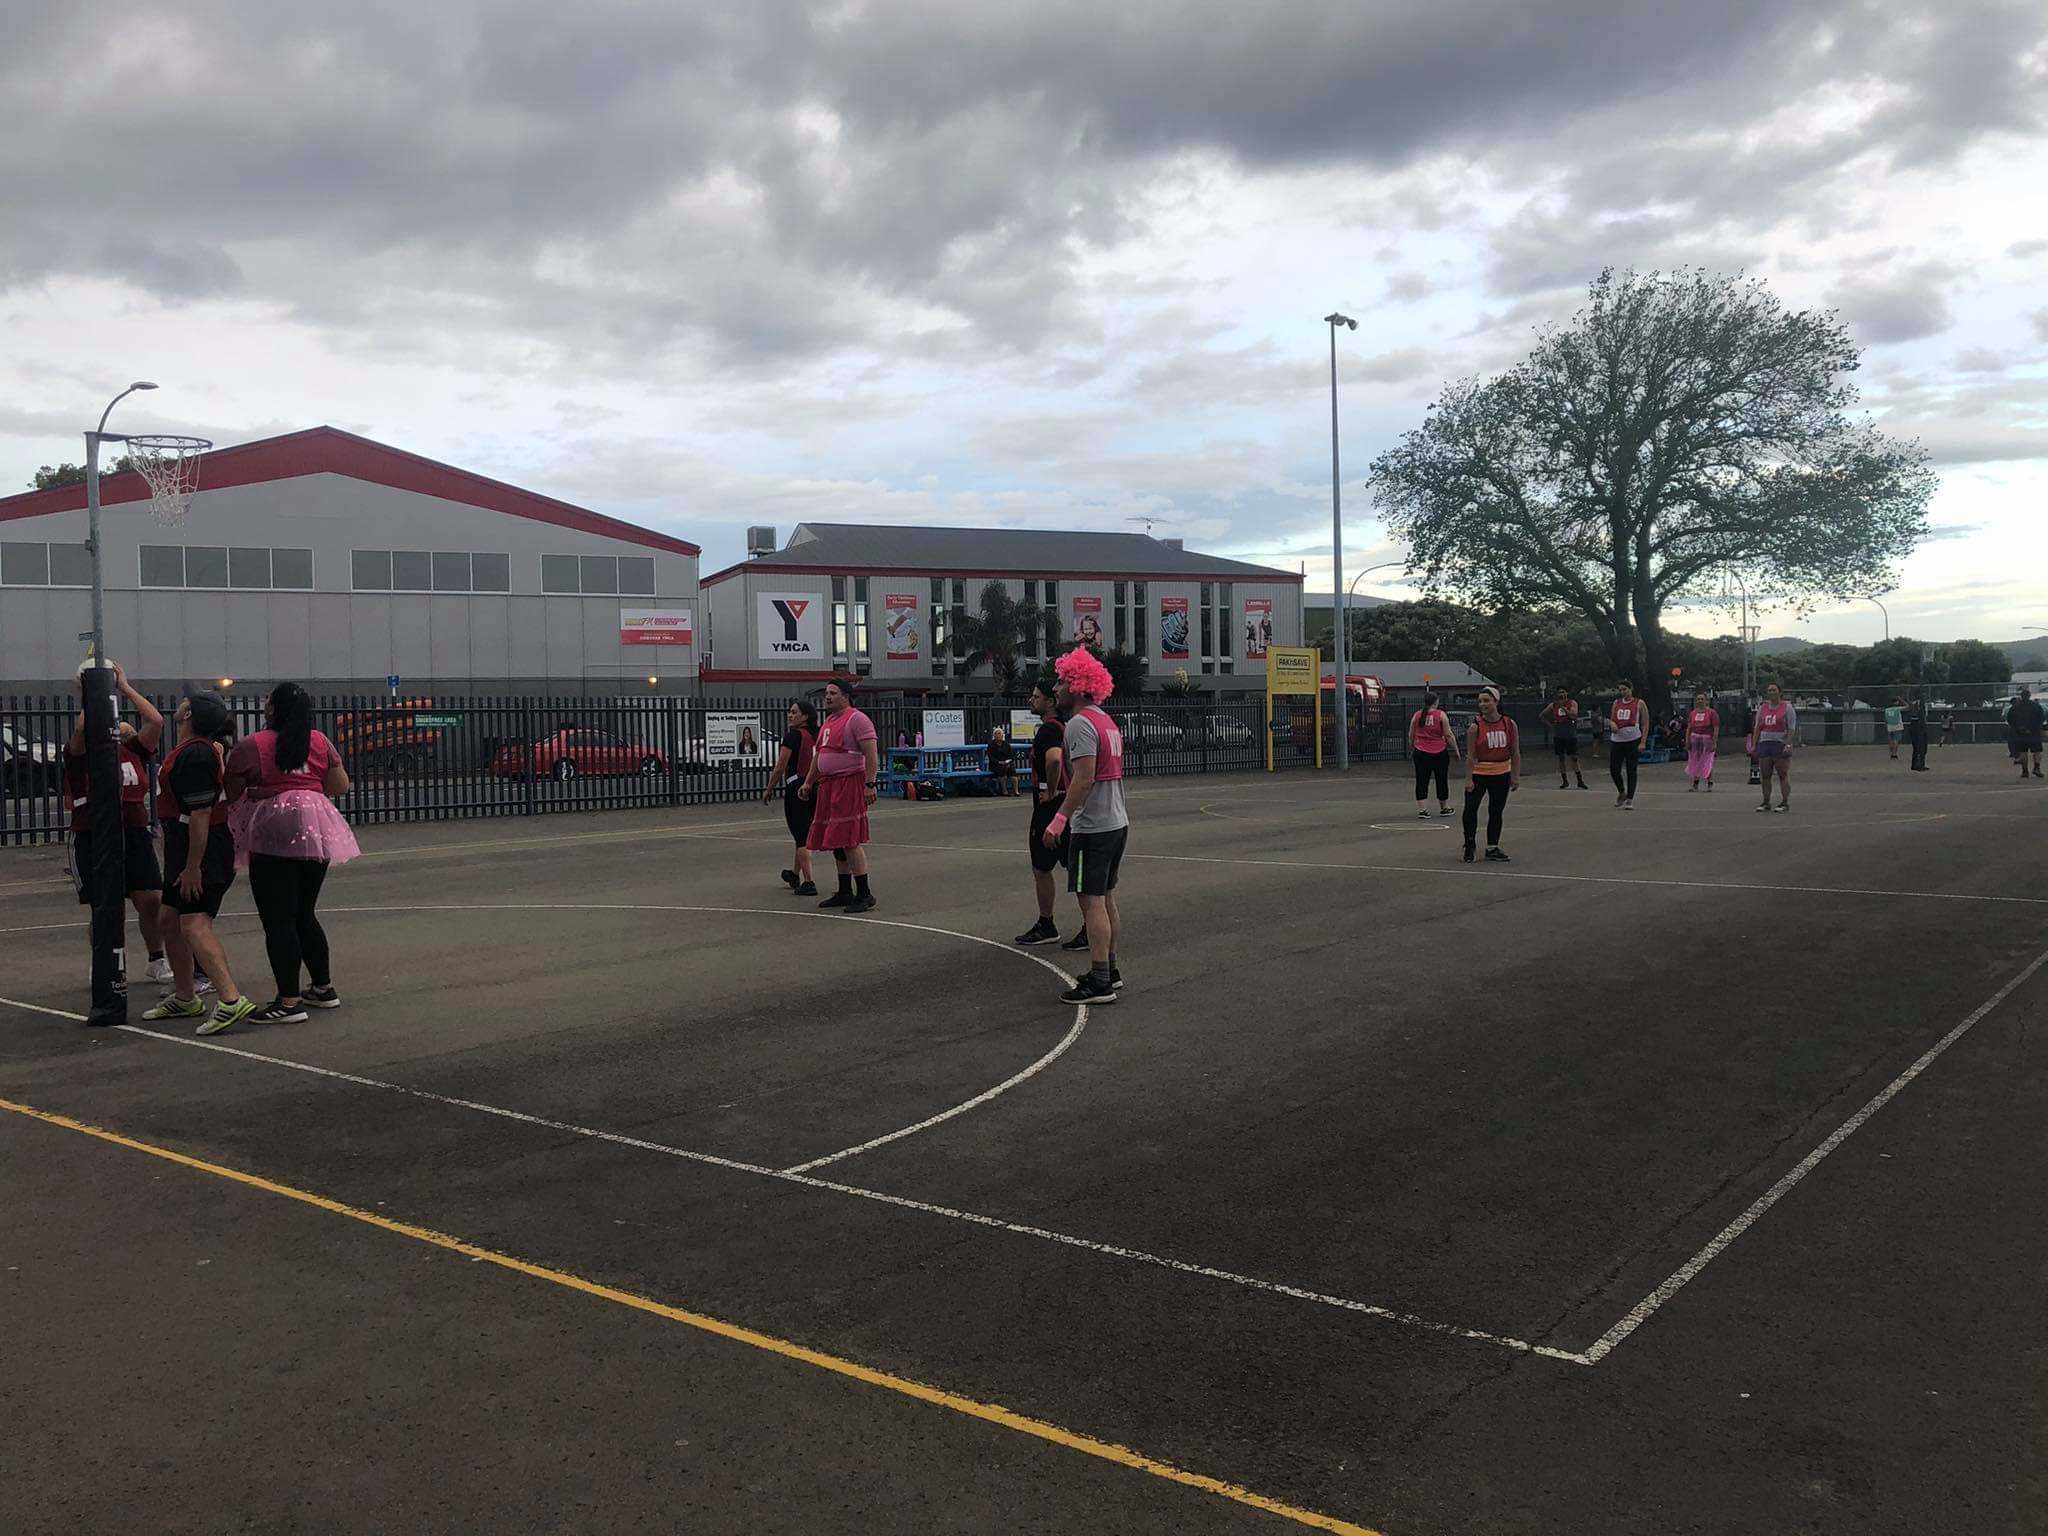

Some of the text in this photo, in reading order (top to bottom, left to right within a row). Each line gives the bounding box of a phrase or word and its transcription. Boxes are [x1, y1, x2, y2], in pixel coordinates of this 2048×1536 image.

[772, 643, 810, 652] YMCA
[934, 711, 961, 723] Coates
[1617, 709, 1631, 720] GD
[1486, 731, 1508, 749] WD
